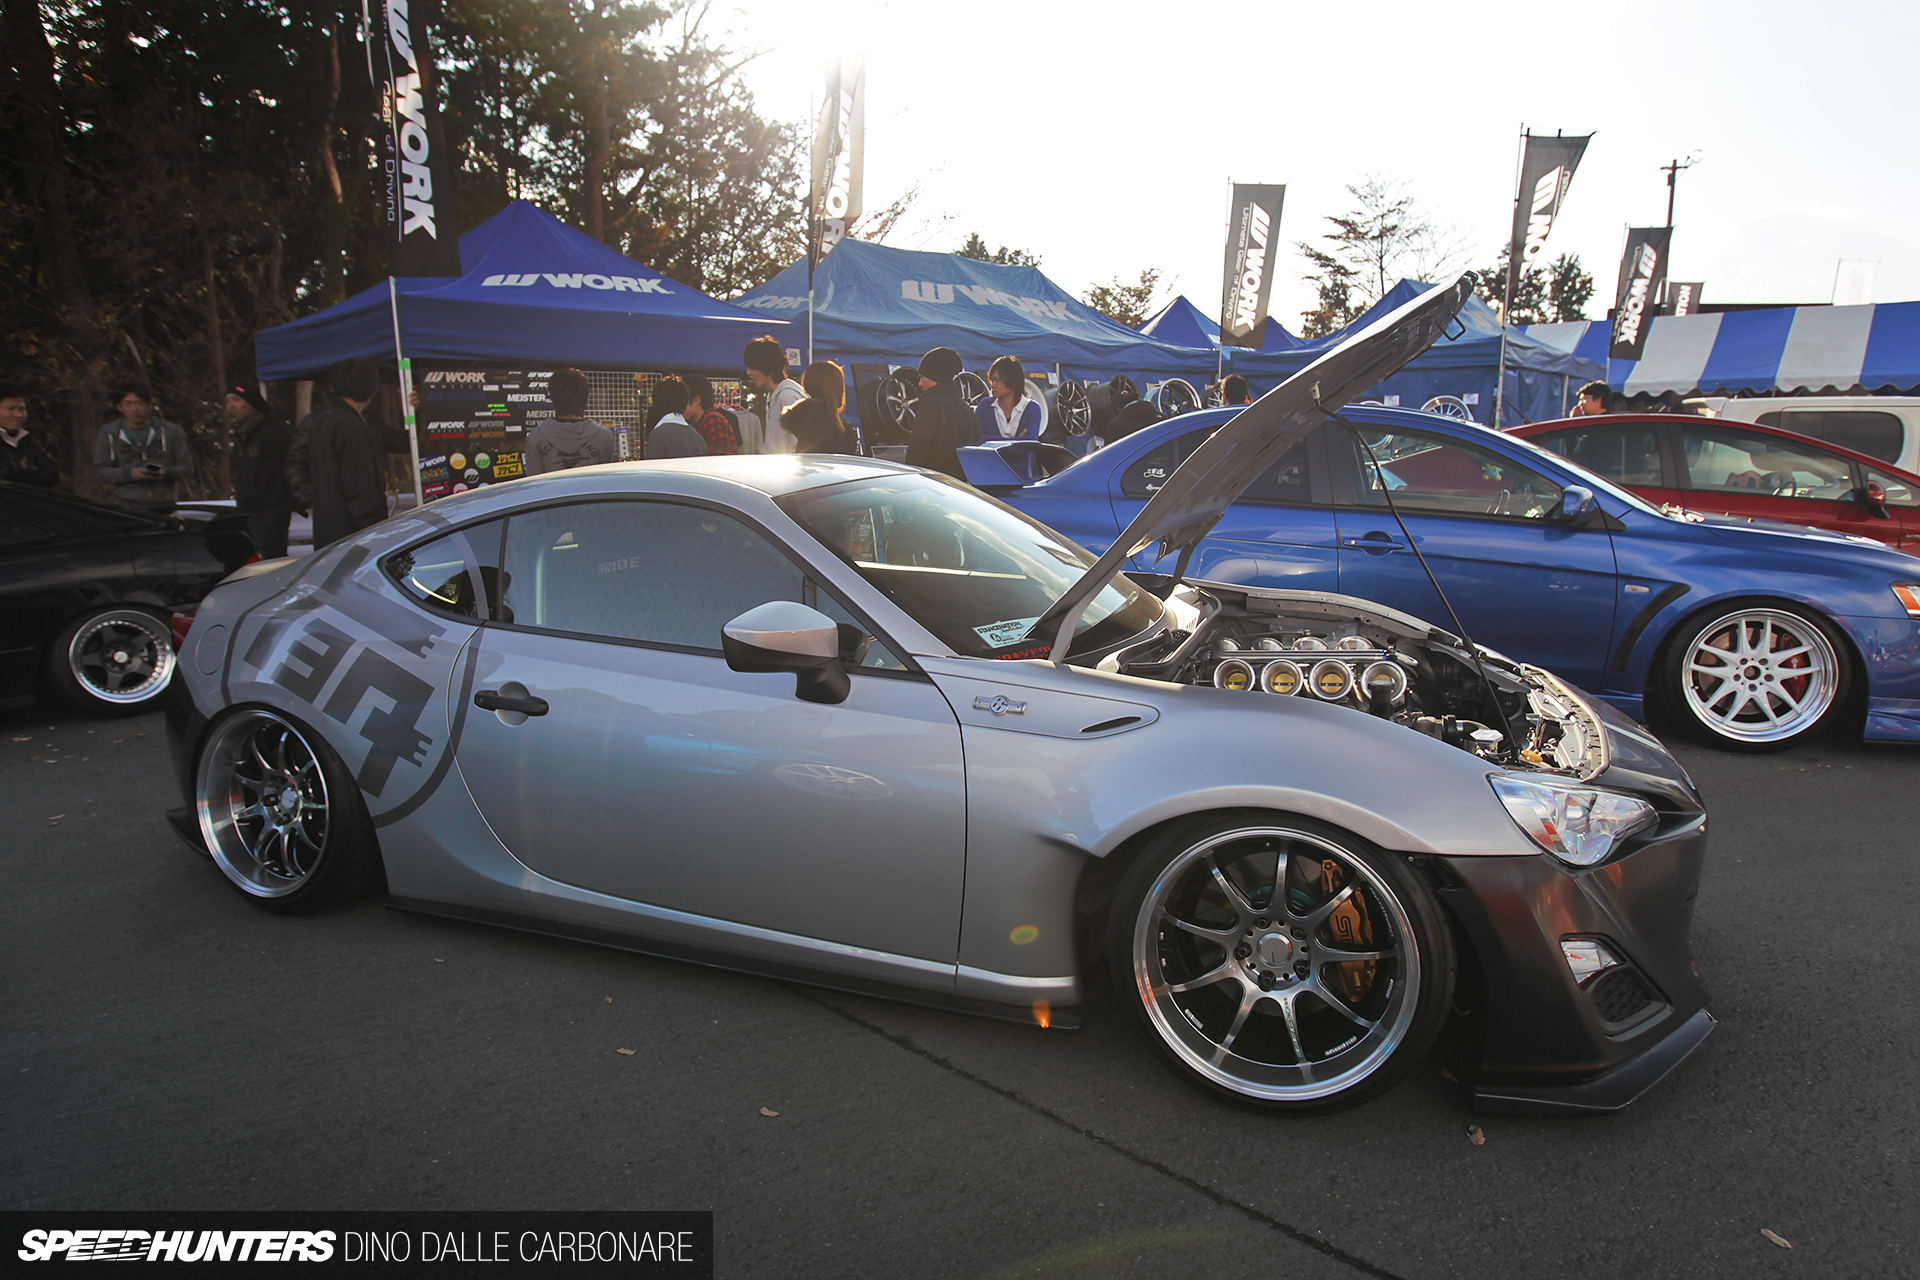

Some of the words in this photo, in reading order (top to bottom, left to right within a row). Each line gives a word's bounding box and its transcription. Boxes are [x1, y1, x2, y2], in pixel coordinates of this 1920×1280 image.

[396, 72, 437, 240] WORK
[1239, 207, 1250, 248] Ultimate
[1235, 249, 1245, 271] Gear
[541, 273, 671, 294] WORK
[1233, 275, 1239, 284] of
[1235, 248, 1266, 331] WORK
[955, 284, 1087, 323] WORK
[1618, 277, 1651, 346] WORK
[445, 371, 486, 383] WORK
[507, 393, 546, 402] MEISTER
[440, 421, 465, 429] WORK
